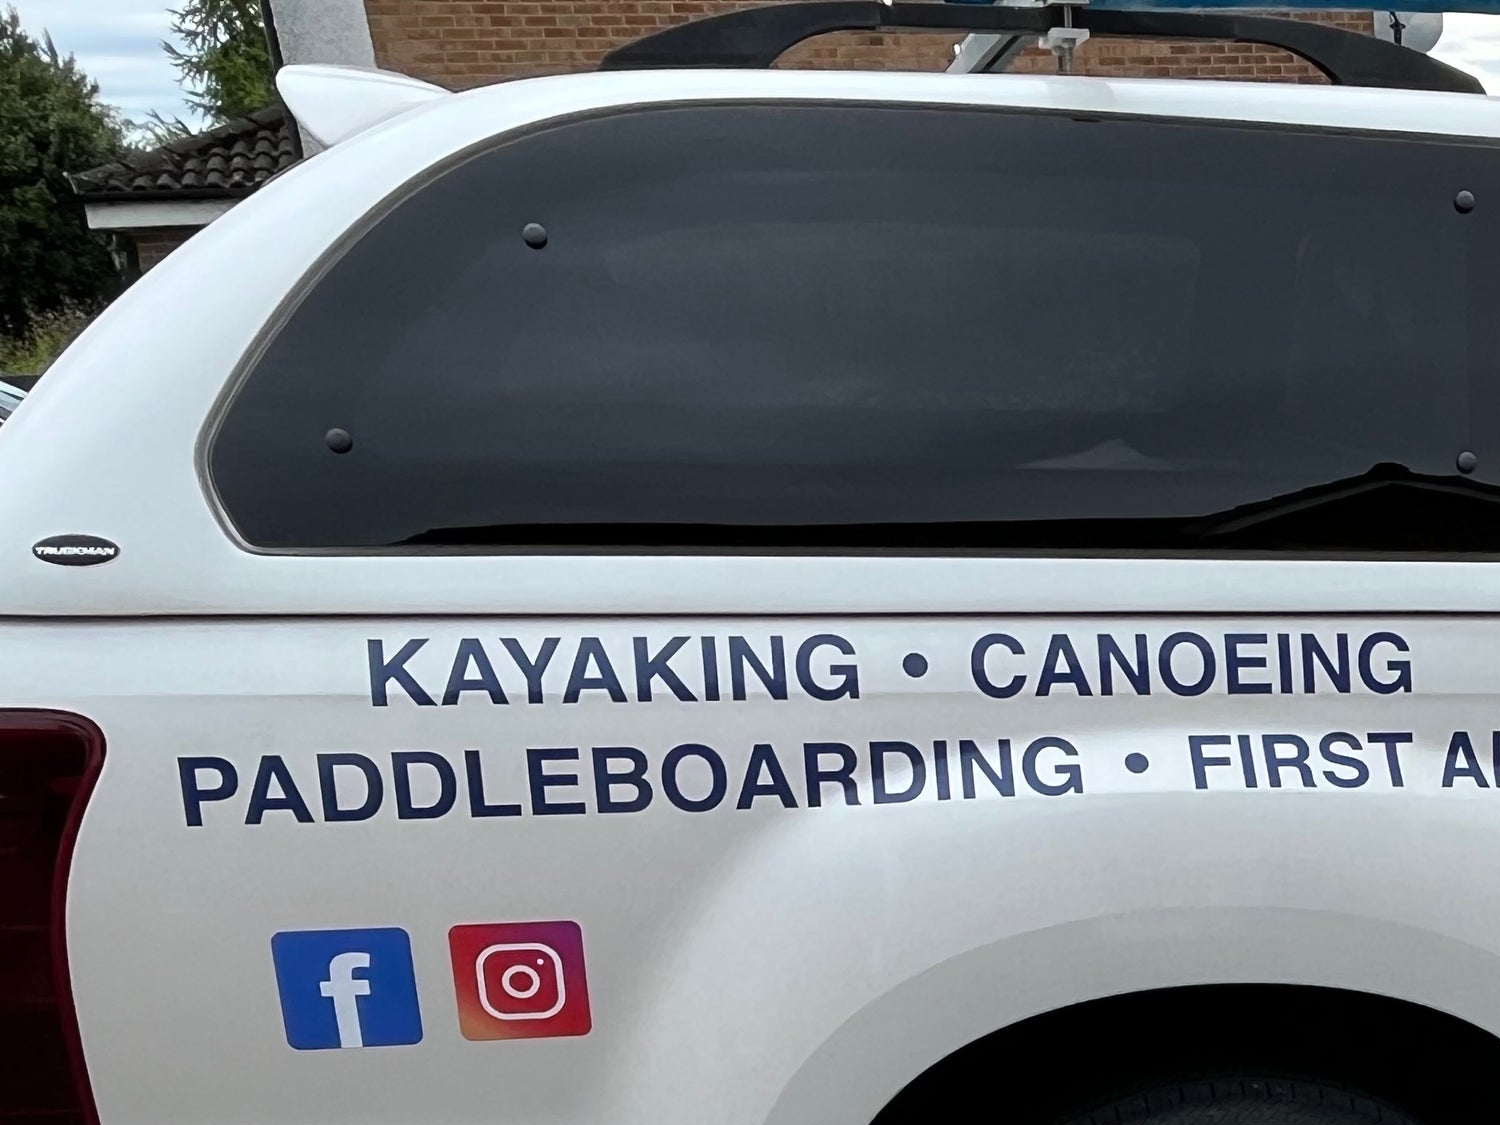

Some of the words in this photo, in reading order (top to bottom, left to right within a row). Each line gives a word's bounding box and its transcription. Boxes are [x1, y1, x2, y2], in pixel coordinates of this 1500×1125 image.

[366, 632, 861, 707] KAYAKING
[970, 631, 1413, 699] CANOEING
[176, 737, 1085, 827] PADDLEBOARDING
[1187, 732, 1414, 790] FIRST
